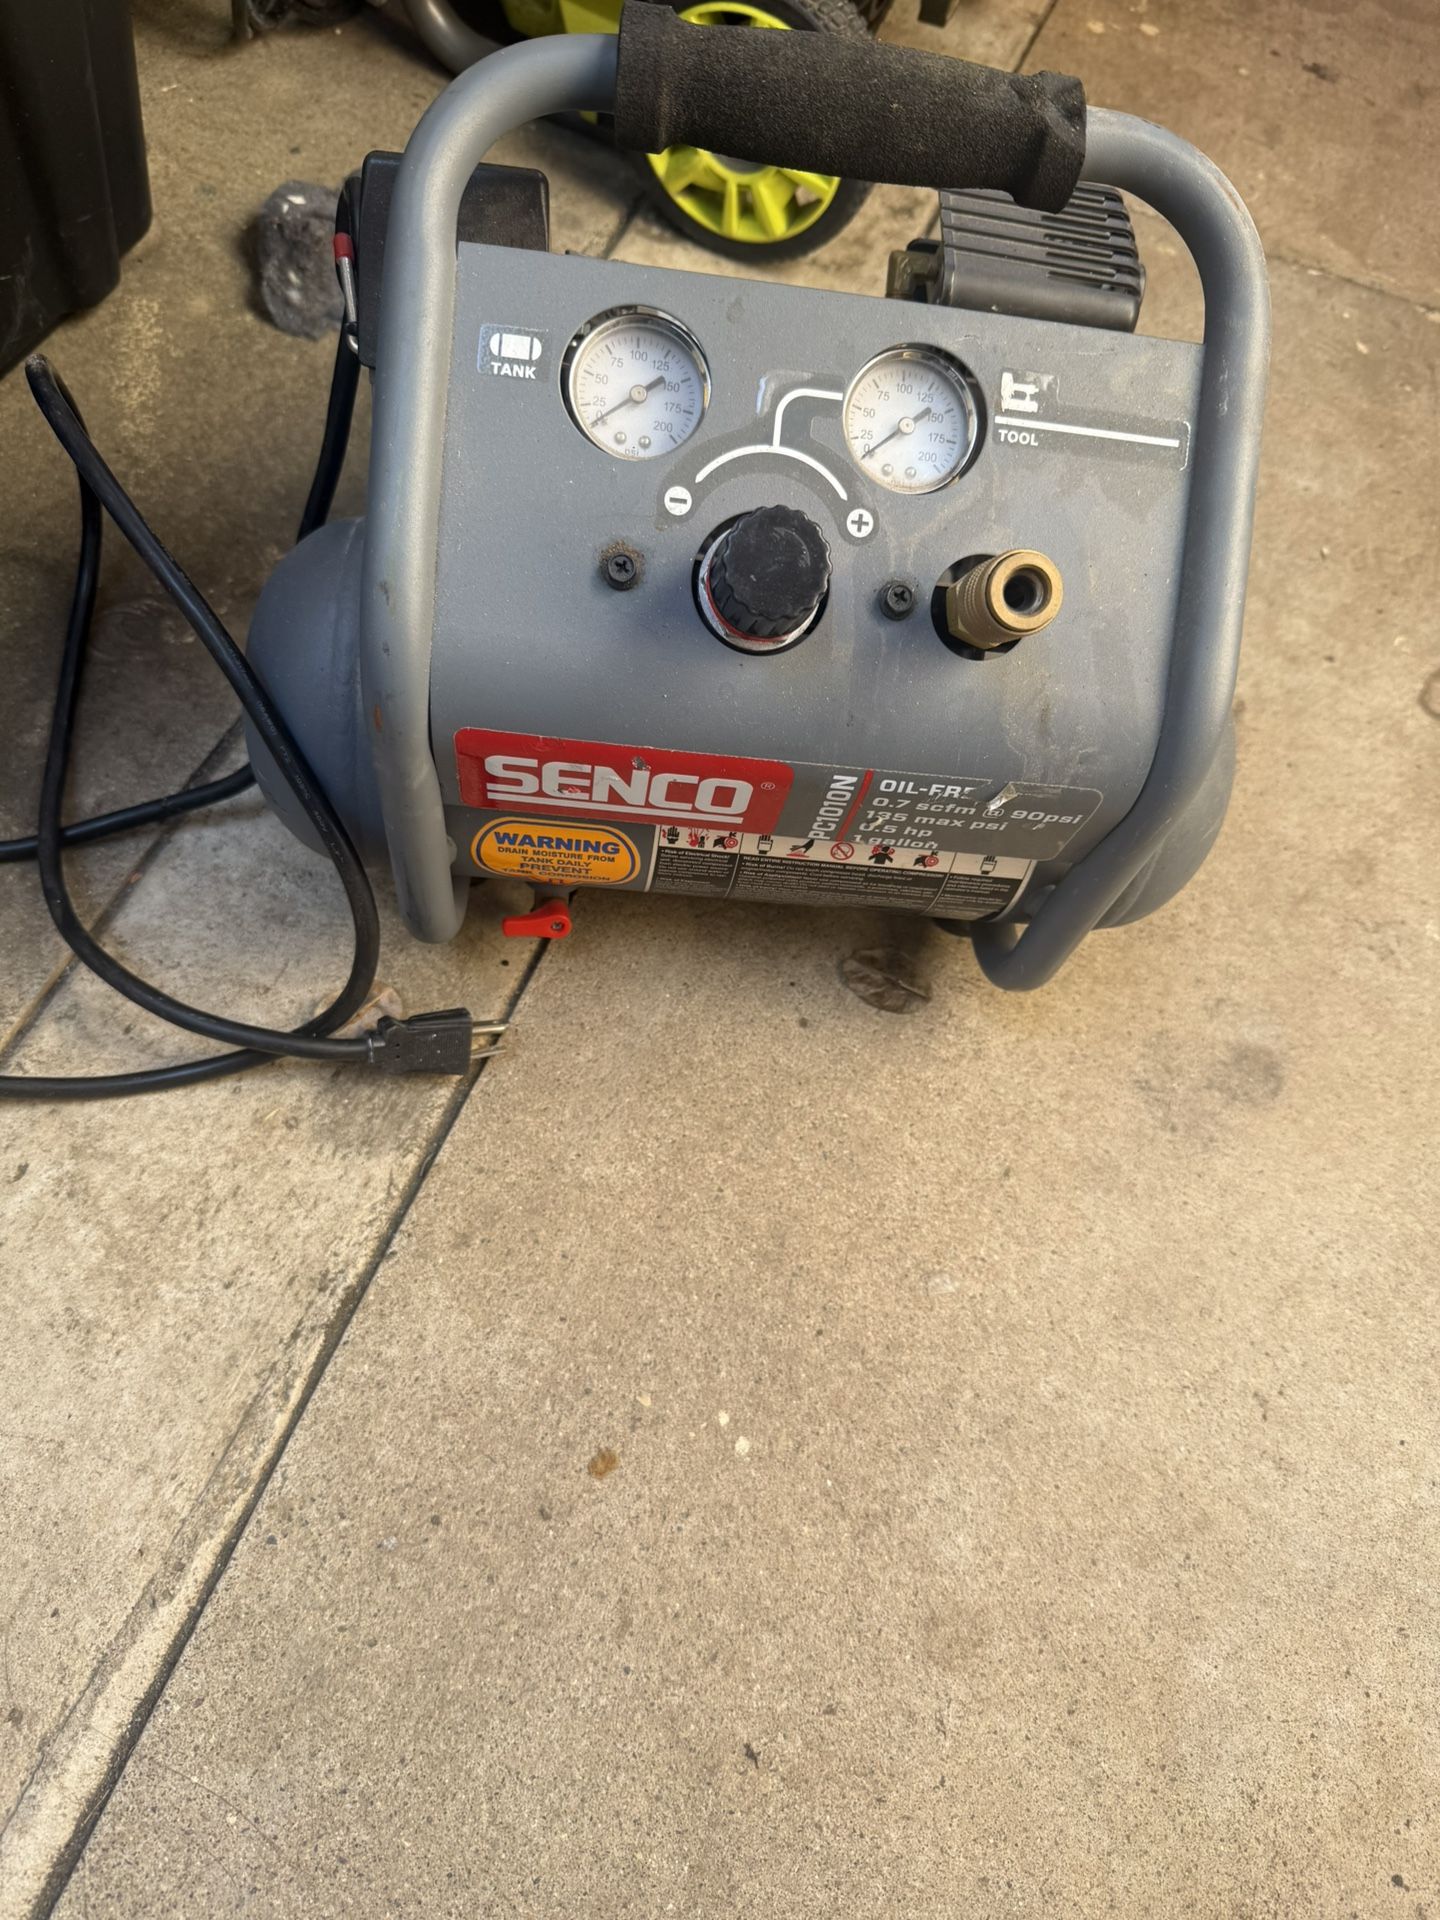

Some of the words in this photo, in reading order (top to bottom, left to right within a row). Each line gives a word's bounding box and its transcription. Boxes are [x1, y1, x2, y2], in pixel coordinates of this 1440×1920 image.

[631, 350, 648, 361] 100
[611, 357, 624, 368] 75
[652, 360, 670, 372] 125
[491, 362, 537, 379] TANK
[595, 375, 608, 385] 50
[663, 381, 680, 392] 150
[896, 383, 913, 394] 100
[593, 396, 606, 407] 25
[877, 391, 890, 401] 75
[917, 392, 934, 403] 125
[664, 402, 682, 413] 175
[863, 408, 875, 418] 50
[927, 413, 943, 424] 150
[653, 421, 673, 432] 200
[861, 430, 873, 440] 25
[929, 432, 945, 443] 175
[998, 429, 1038, 446] TOOL
[918, 451, 937, 462] 200
[484, 755, 753, 814] SENCO
[808, 775, 858, 840] PC1010N
[872, 797, 911, 809] 0.7
[915, 802, 977, 815] scfm
[1011, 810, 1083, 824] 90psi
[866, 810, 909, 821] 135
[914, 816, 966, 827] max
[969, 821, 1008, 831] psi
[904, 826, 933, 837] hp
[494, 831, 620, 855] WARNING
[869, 837, 938, 849] gallon
[498, 846, 528, 855] DRAIN
[533, 850, 582, 860] MOISTURE
[588, 855, 615, 863] FROM
[521, 856, 554, 865] TANK
[557, 859, 591, 868] DAILY
[520, 863, 592, 874] PREVENT
